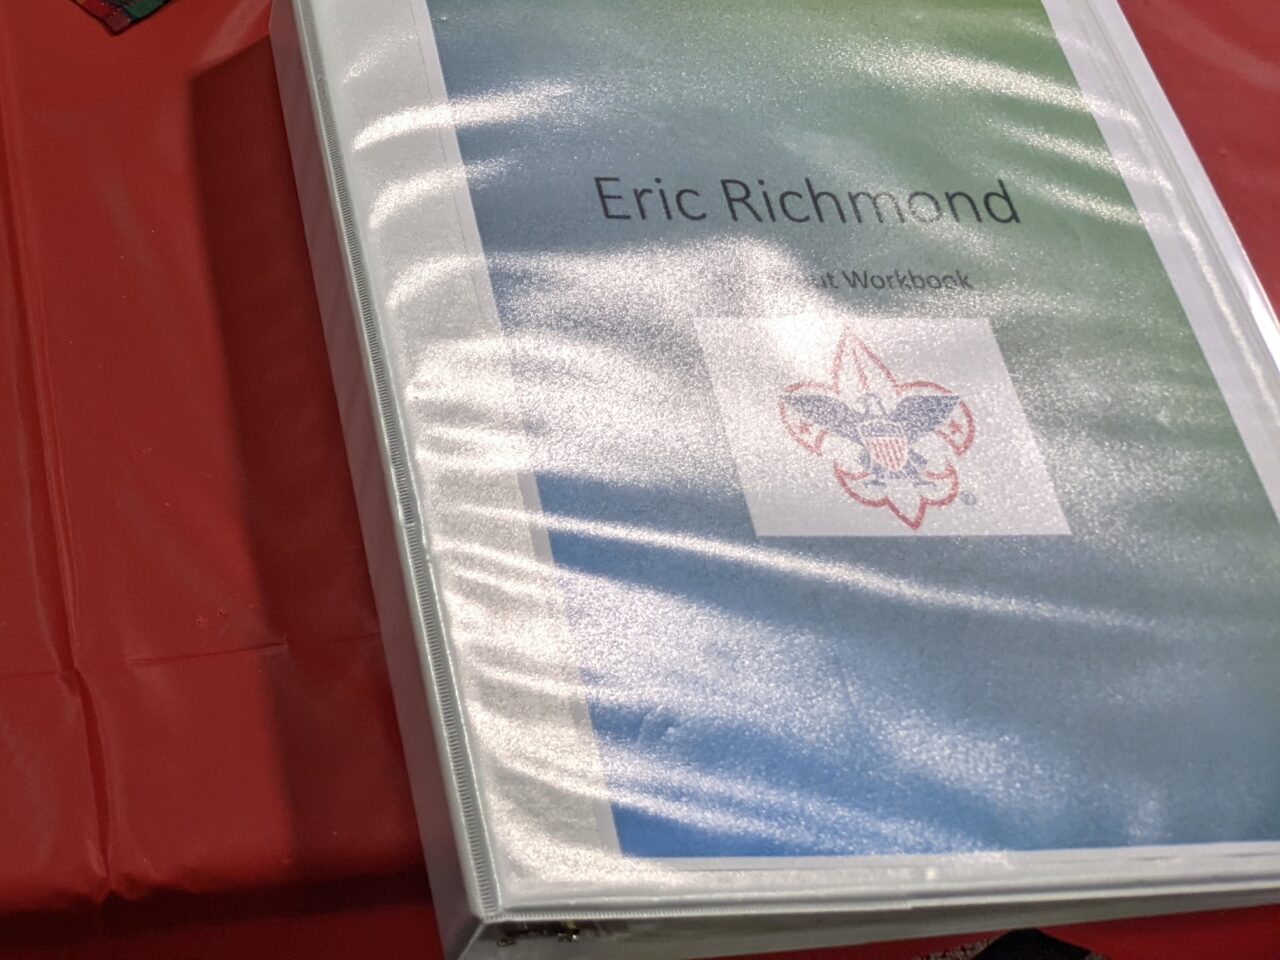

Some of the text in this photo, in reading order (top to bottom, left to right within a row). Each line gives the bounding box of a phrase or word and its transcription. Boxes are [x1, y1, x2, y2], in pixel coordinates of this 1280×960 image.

[594, 176, 1020, 224] Eric Richmond
[841, 268, 974, 290] Workbook
